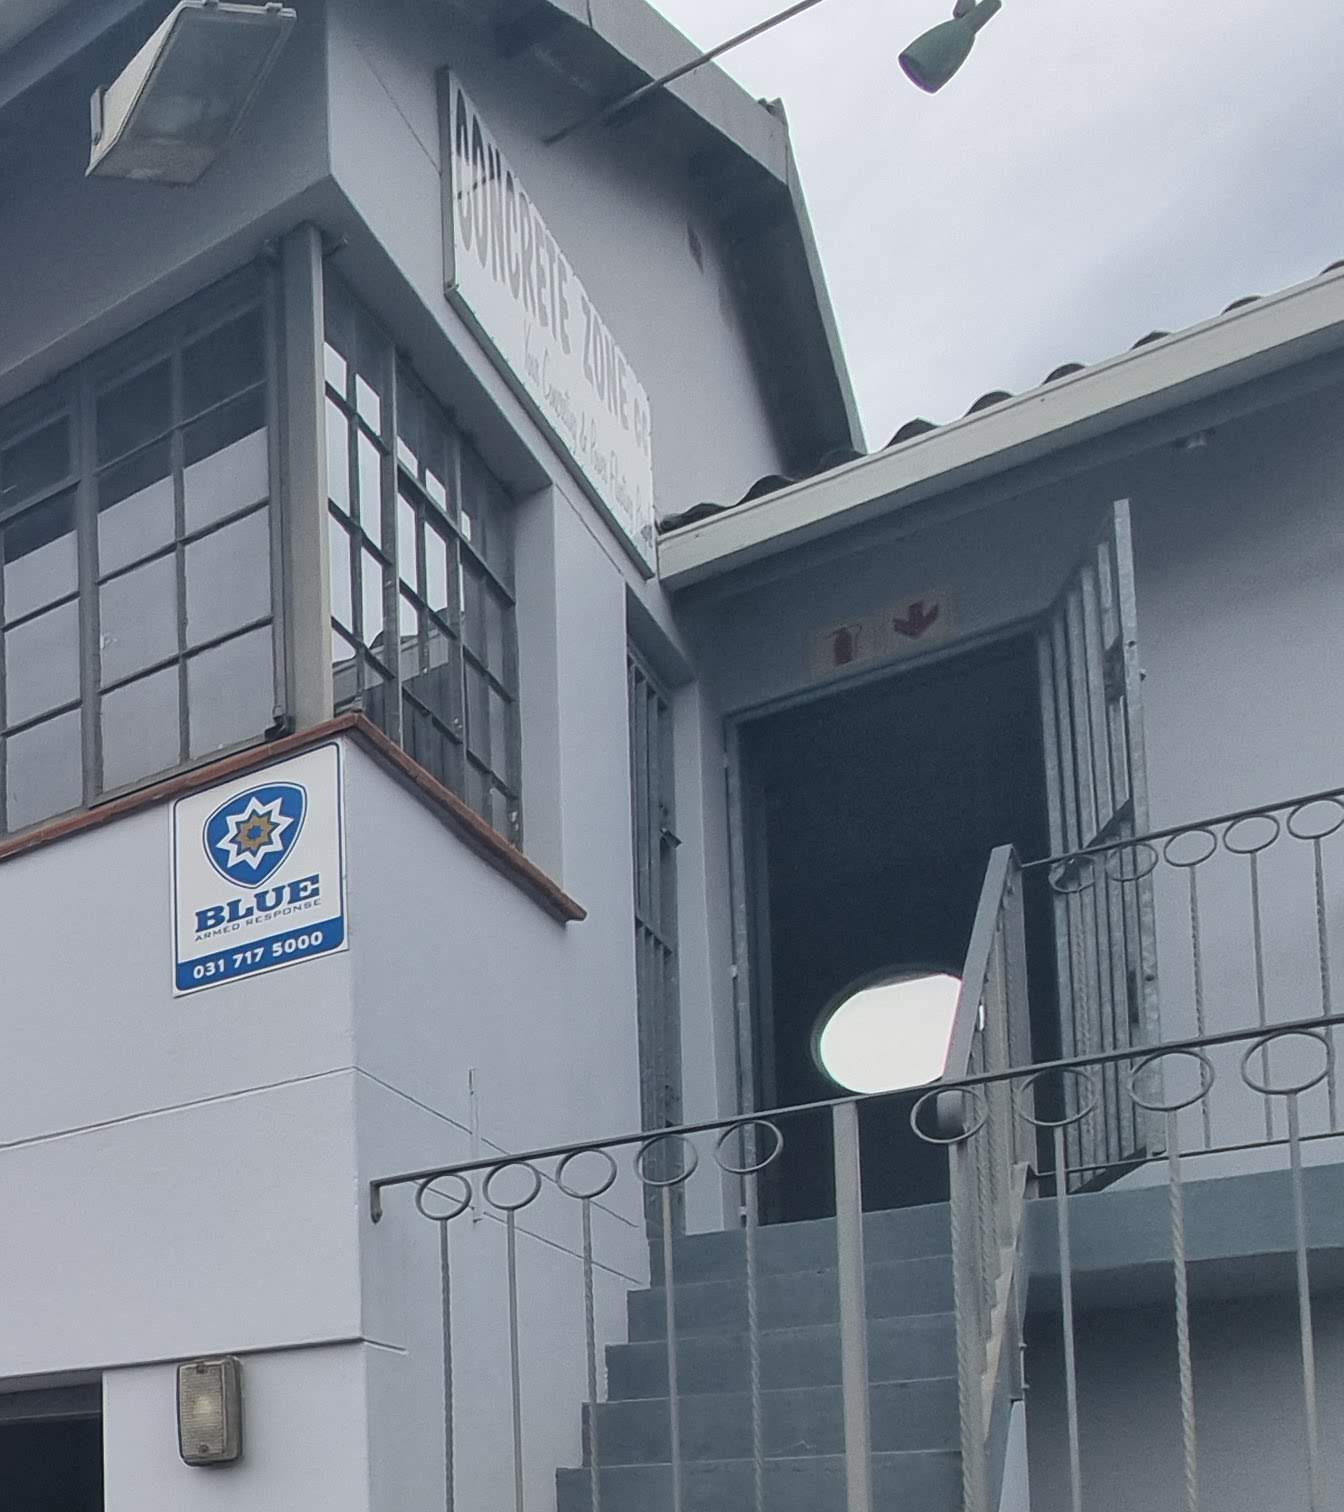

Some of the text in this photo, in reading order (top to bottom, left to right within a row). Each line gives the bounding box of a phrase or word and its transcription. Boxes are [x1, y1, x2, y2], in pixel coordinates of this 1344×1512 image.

[455, 87, 572, 356] CONCRETE
[580, 293, 630, 431] ZONE
[195, 873, 320, 933] BLUE
[195, 898, 322, 942] ARMED RESPONSE
[193, 931, 324, 979] 031 717 5000
